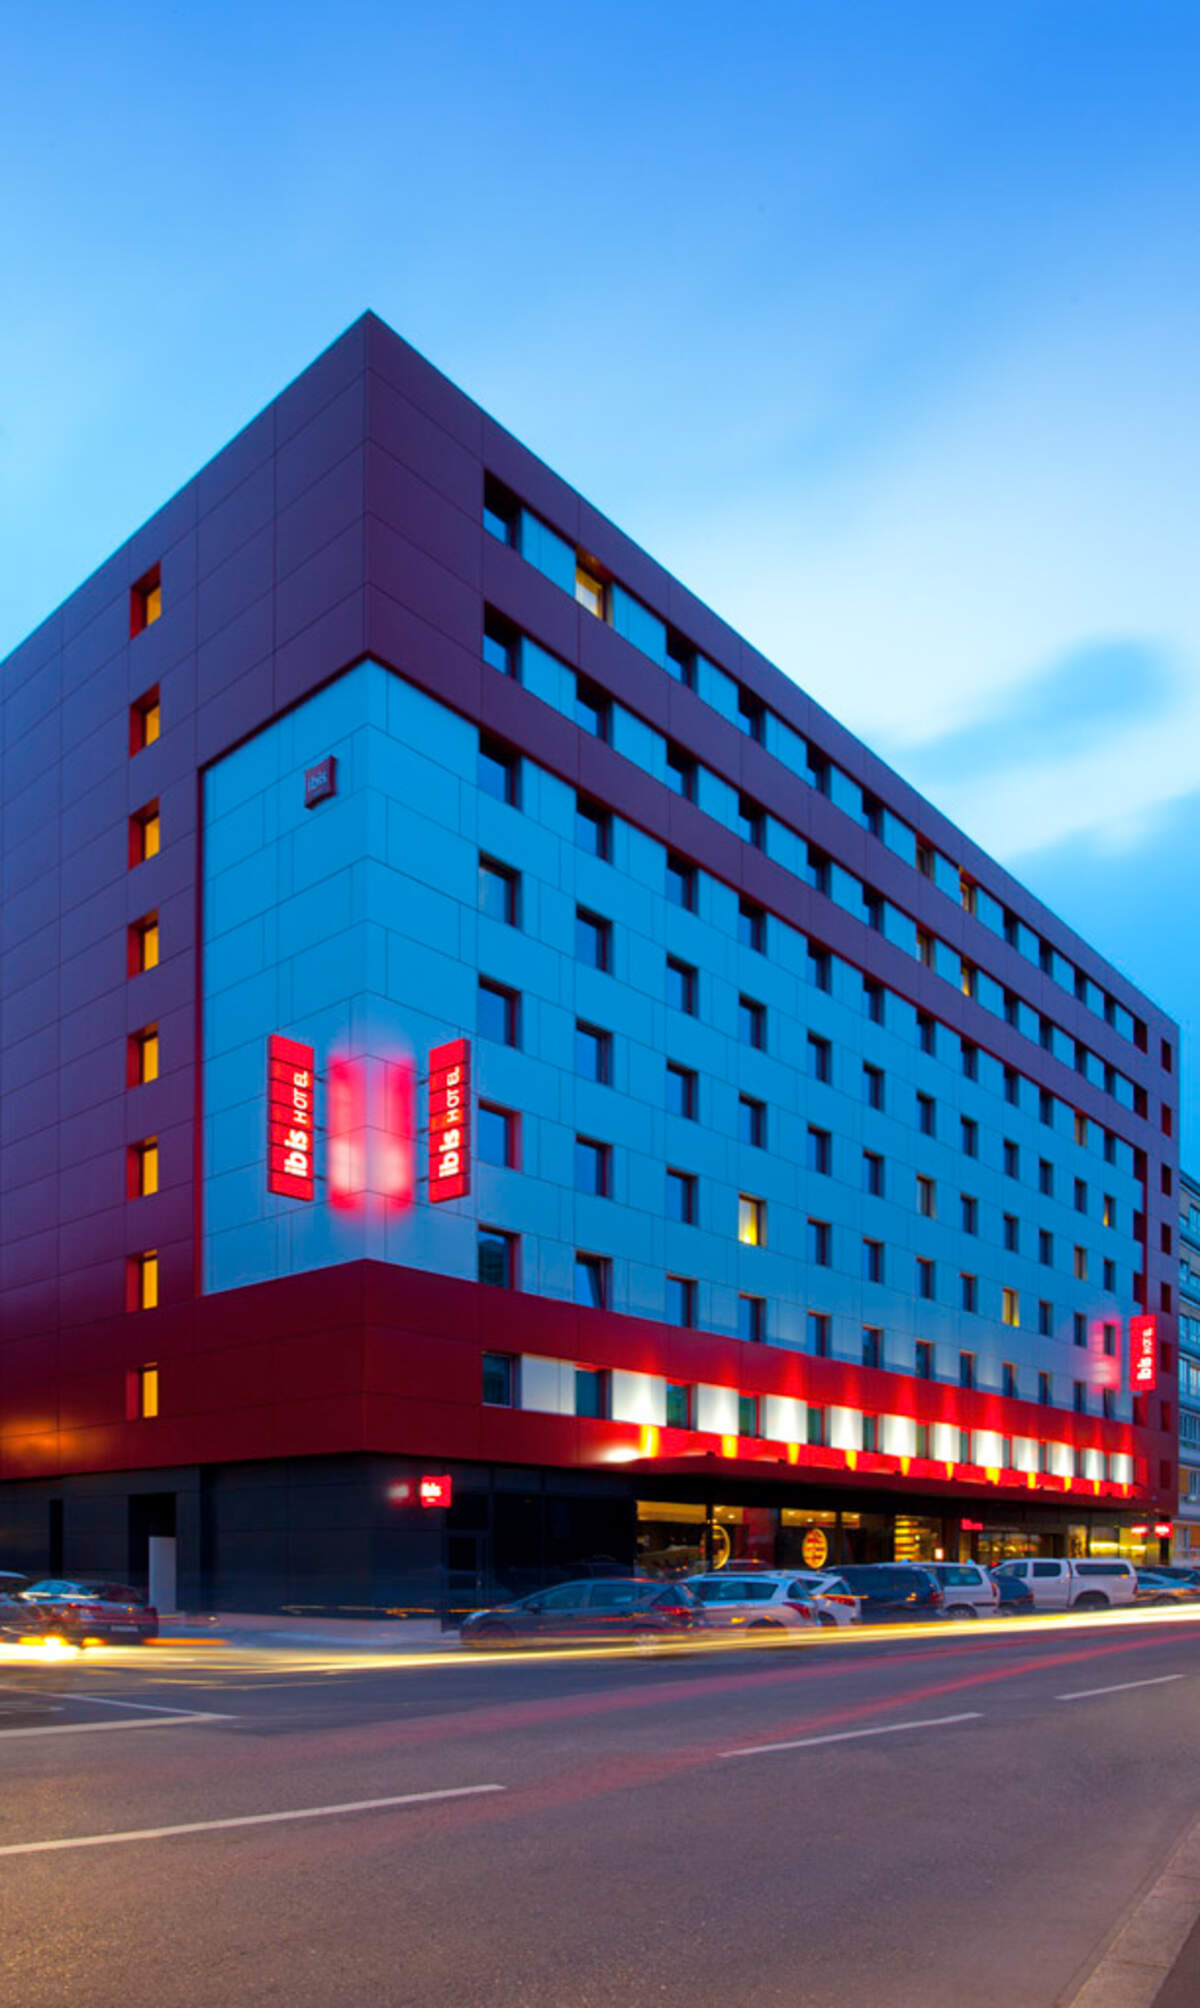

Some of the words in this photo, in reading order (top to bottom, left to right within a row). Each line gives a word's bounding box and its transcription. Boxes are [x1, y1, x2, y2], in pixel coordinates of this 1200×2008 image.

[293, 1070, 309, 1125] HOTEL
[446, 1066, 461, 1124] HOTEL
[284, 1129, 309, 1177] ibis
[438, 1128, 461, 1178] ibis
